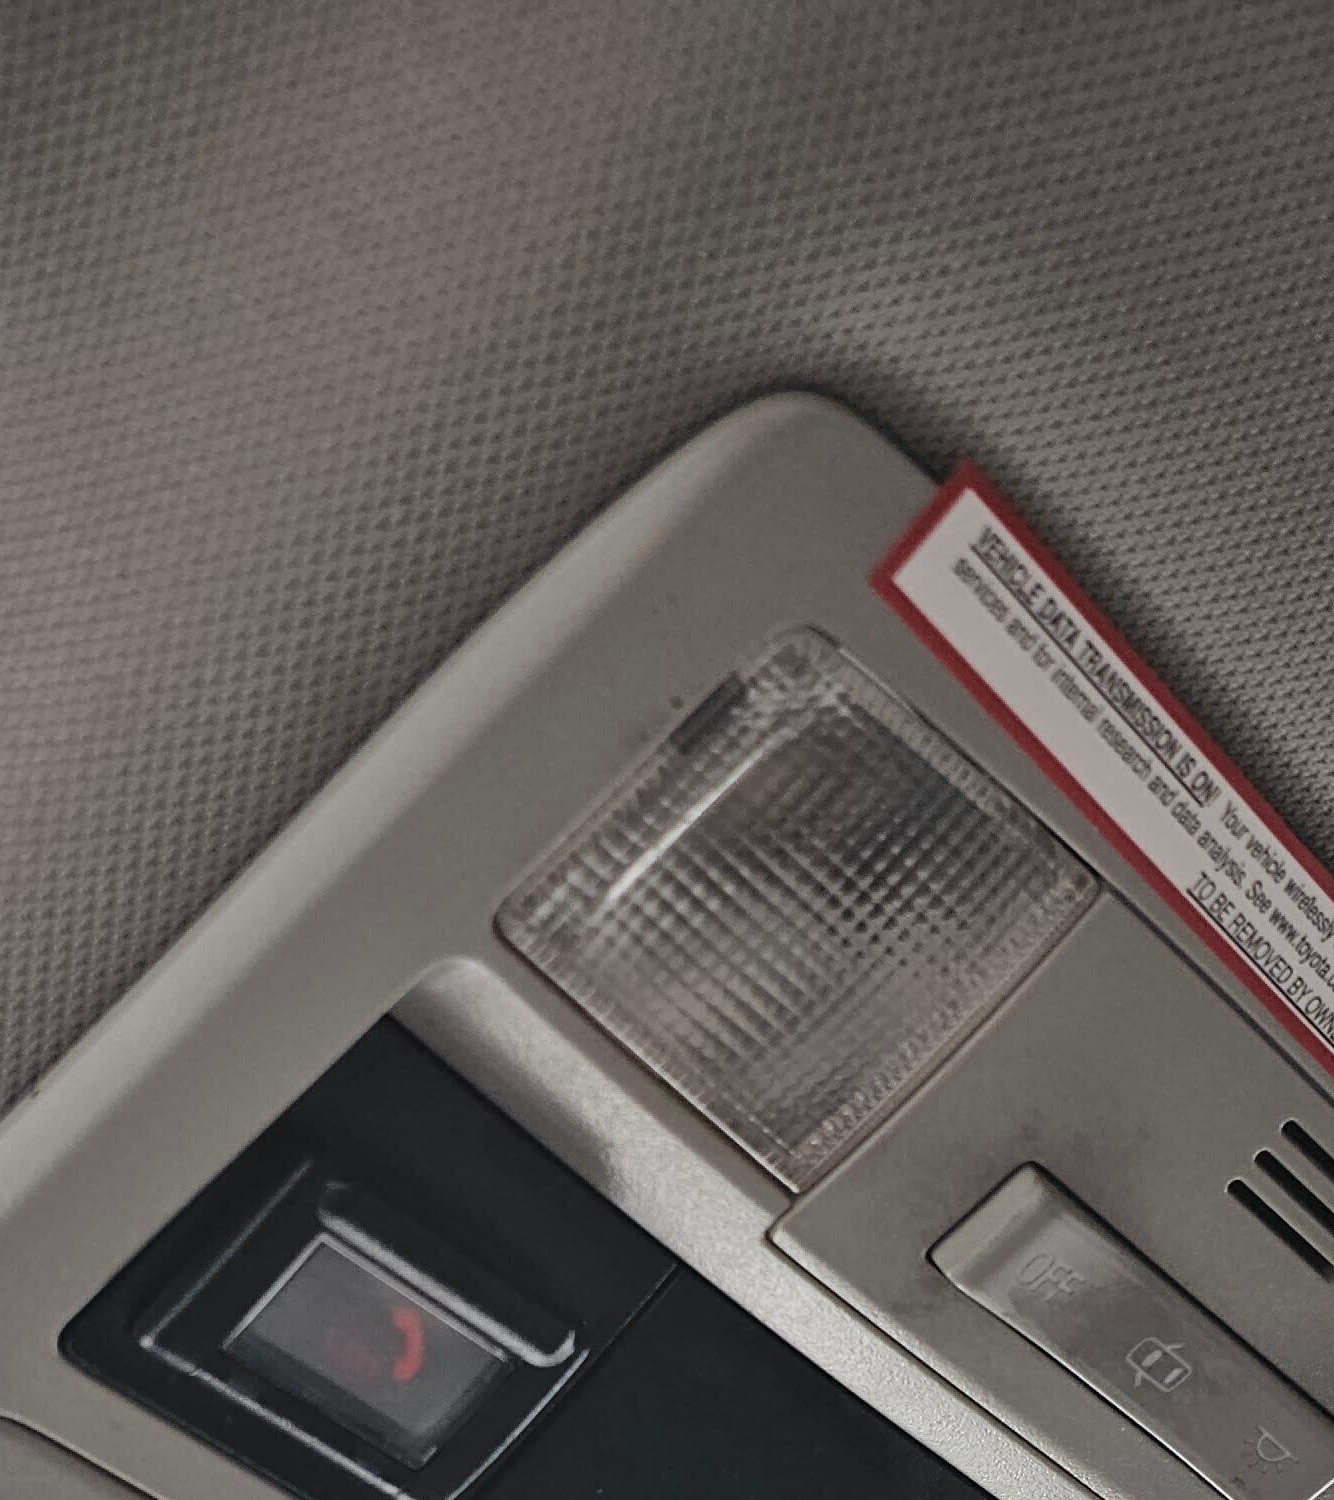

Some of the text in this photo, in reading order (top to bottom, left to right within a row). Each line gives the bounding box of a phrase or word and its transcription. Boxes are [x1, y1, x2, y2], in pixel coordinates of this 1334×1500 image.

[1145, 770, 1181, 808] and
[1168, 795, 1206, 837] data
[1191, 825, 1254, 893] analysis.
[1243, 877, 1277, 915] See
[1173, 751, 1197, 778] IS
[1215, 800, 1253, 841] Your
[1241, 831, 1291, 885] vehicle
[1188, 870, 1219, 903] TO
[1208, 892, 1236, 922] BE
[1226, 910, 1297, 986] REMOVED
[1285, 975, 1314, 1005] BY
[1017, 1252, 1088, 1303] OFF
